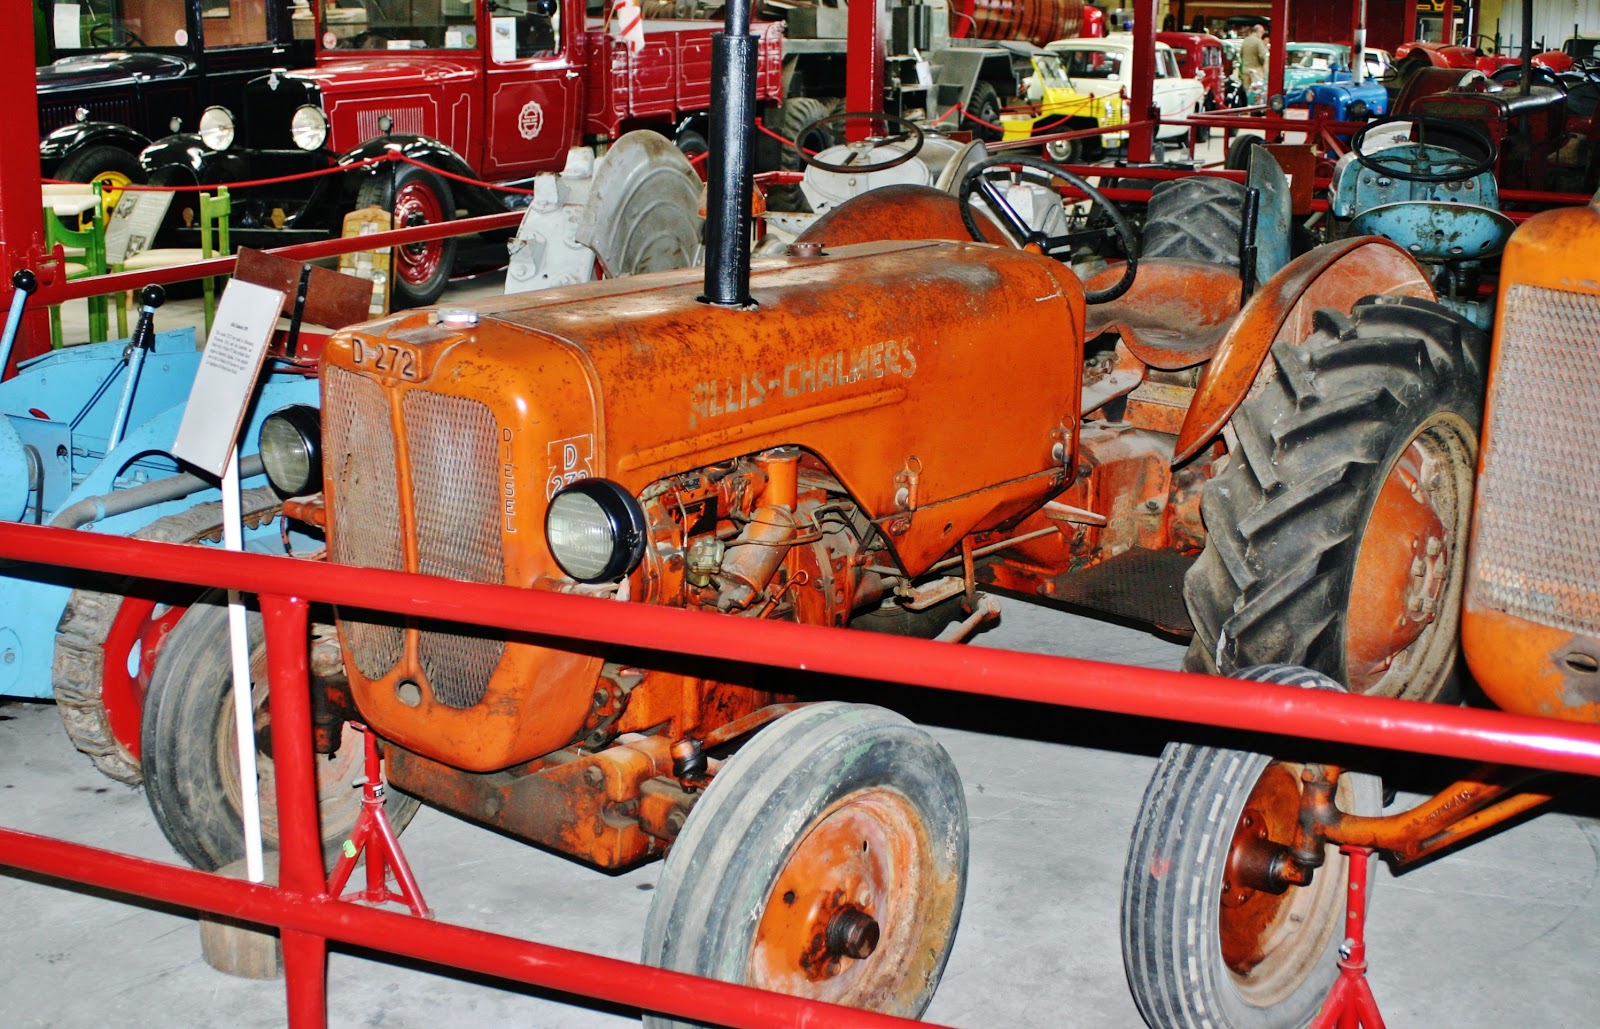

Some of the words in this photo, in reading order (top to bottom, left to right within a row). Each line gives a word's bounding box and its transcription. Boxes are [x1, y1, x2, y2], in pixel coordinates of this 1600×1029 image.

[351, 337, 417, 378] D-272
[689, 337, 917, 430] ALLIS-CHALMERS
[502, 428, 517, 534] DIESEL
[564, 443, 578, 470] D
